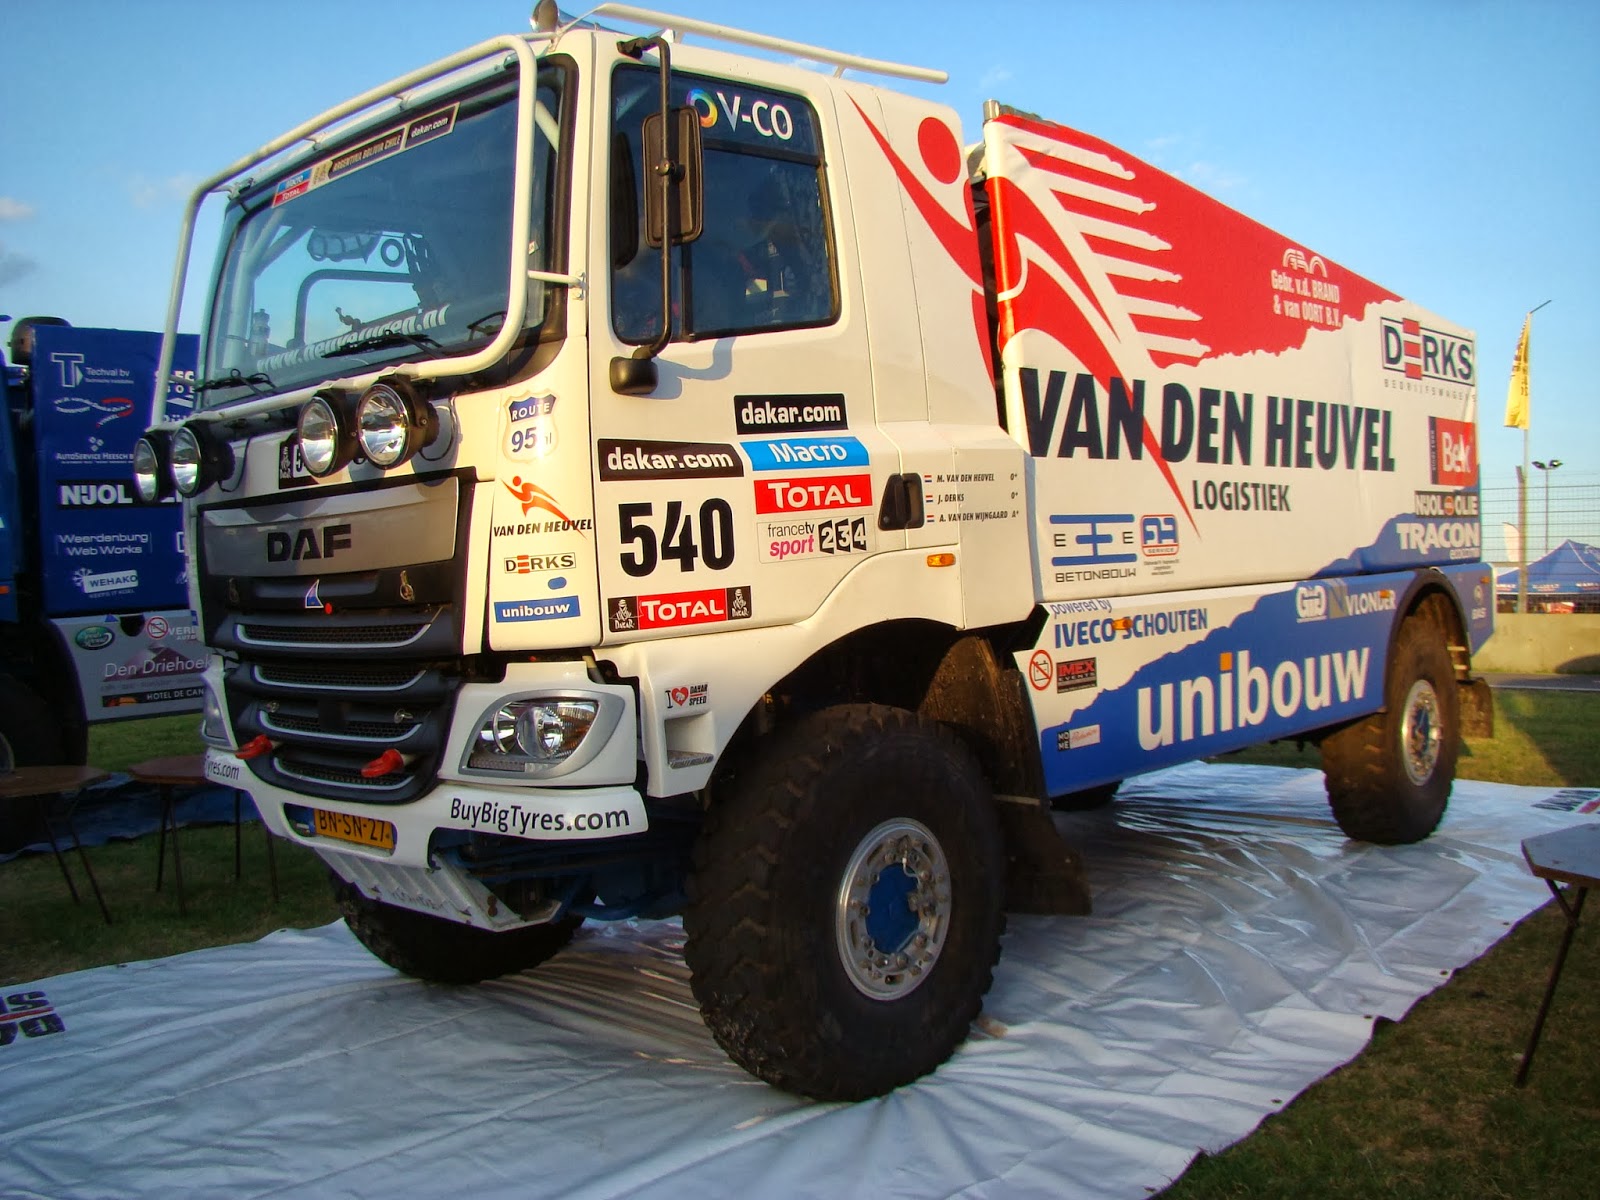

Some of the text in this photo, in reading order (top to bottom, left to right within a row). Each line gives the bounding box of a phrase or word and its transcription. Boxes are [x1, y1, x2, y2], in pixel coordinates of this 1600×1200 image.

[411, 117, 448, 138] dakar.com
[282, 188, 300, 200] TOTAL
[1384, 318, 1472, 380] DERKS
[512, 403, 550, 421] ROUTE
[741, 401, 841, 425] dakar.com
[1019, 367, 1146, 461] VAN
[1161, 382, 1254, 467] DEN
[1265, 395, 1396, 472] HEUVEL
[607, 446, 734, 471] dakar.com
[768, 441, 847, 463] Macro
[946, 474, 959, 483] VAN
[960, 473, 972, 482] DEN
[973, 473, 995, 482] HEUVEL
[767, 481, 862, 509] TOTAL
[944, 494, 964, 502] DERKS
[1193, 480, 1291, 512] LOGISTIEK
[493, 518, 592, 537] VAN DEN HEUVEL
[948, 514, 961, 522] VAN
[962, 513, 974, 521] DEN
[618, 497, 735, 578] 540
[767, 521, 815, 538] francetv
[1396, 522, 1480, 554] TRACON
[66, 545, 143, 556] Web Works
[267, 524, 351, 562] DAF
[769, 534, 815, 560] sport
[505, 555, 574, 574] DERKS
[89, 575, 138, 587] WEHAKO
[1055, 568, 1136, 583] BETONBOUW
[502, 603, 570, 618] unibouw
[641, 599, 724, 622] TOTAL
[1050, 598, 1112, 619] powered by
[1055, 608, 1207, 648] IVECO SCHOUTEN
[104, 663, 136, 677] Den
[1058, 660, 1095, 677] IMEX
[146, 690, 172, 700] HOTEL
[174, 690, 185, 698] DE
[1137, 647, 1369, 751] unibouw
[450, 797, 629, 834] BuyBigTyres.com
